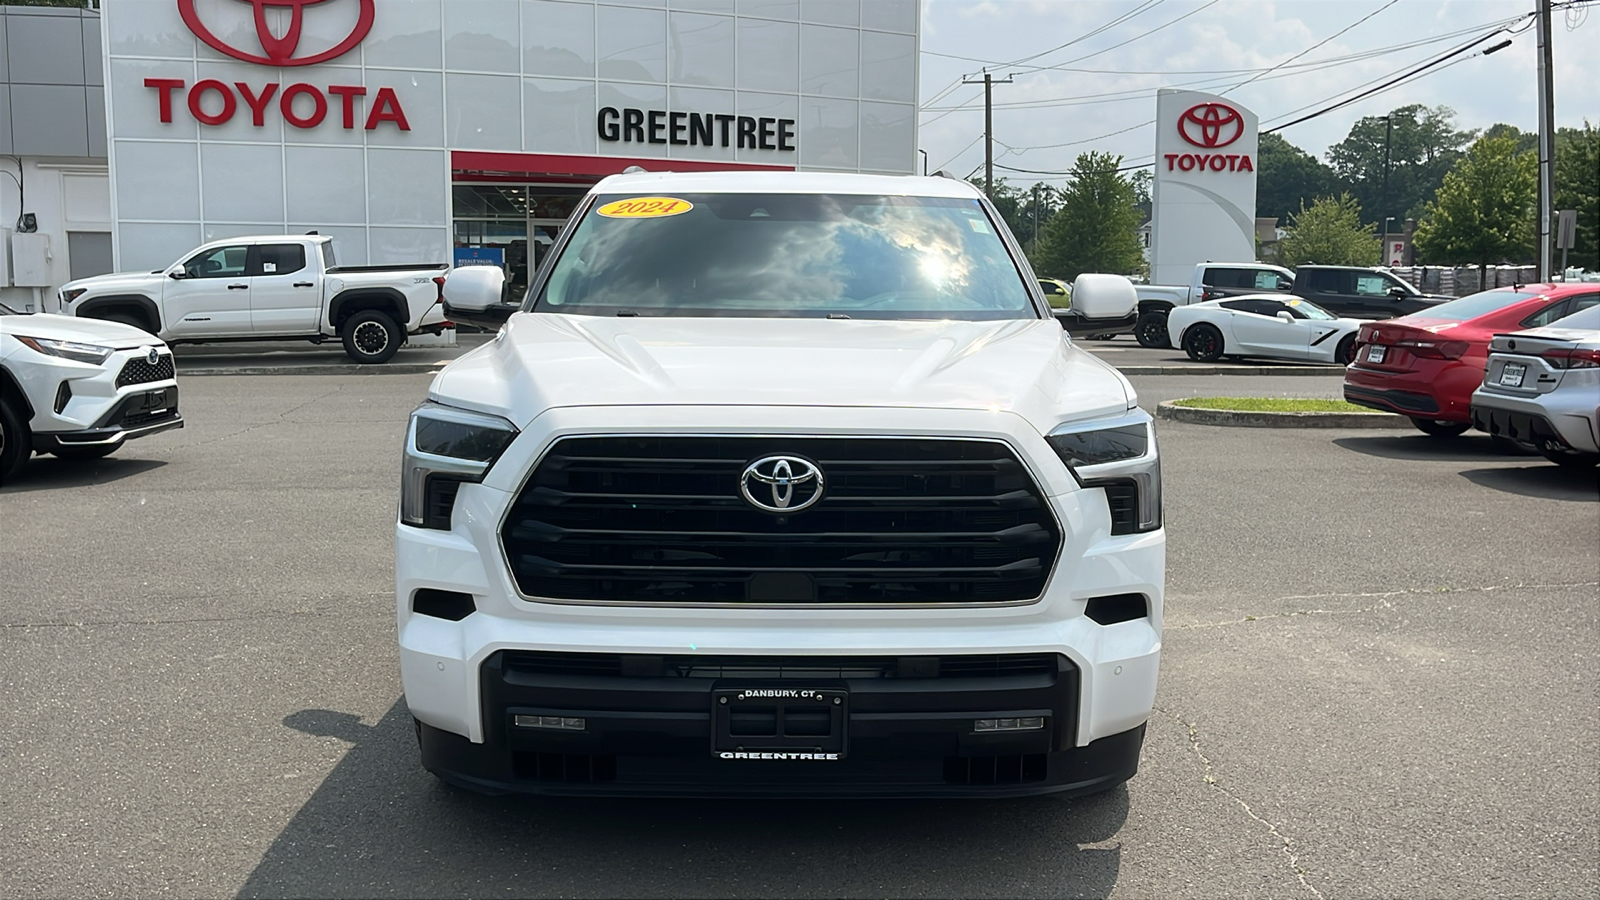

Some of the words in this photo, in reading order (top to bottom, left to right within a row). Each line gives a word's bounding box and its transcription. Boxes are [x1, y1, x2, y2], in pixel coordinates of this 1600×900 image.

[144, 78, 411, 131] TOYOTA
[597, 106, 796, 151] GREENTREE
[1164, 153, 1254, 172] TOYOTA
[610, 201, 680, 215] 2024
[745, 690, 798, 698] DANBURY,
[801, 690, 816, 698] CT
[720, 752, 838, 760] GREENTREE
